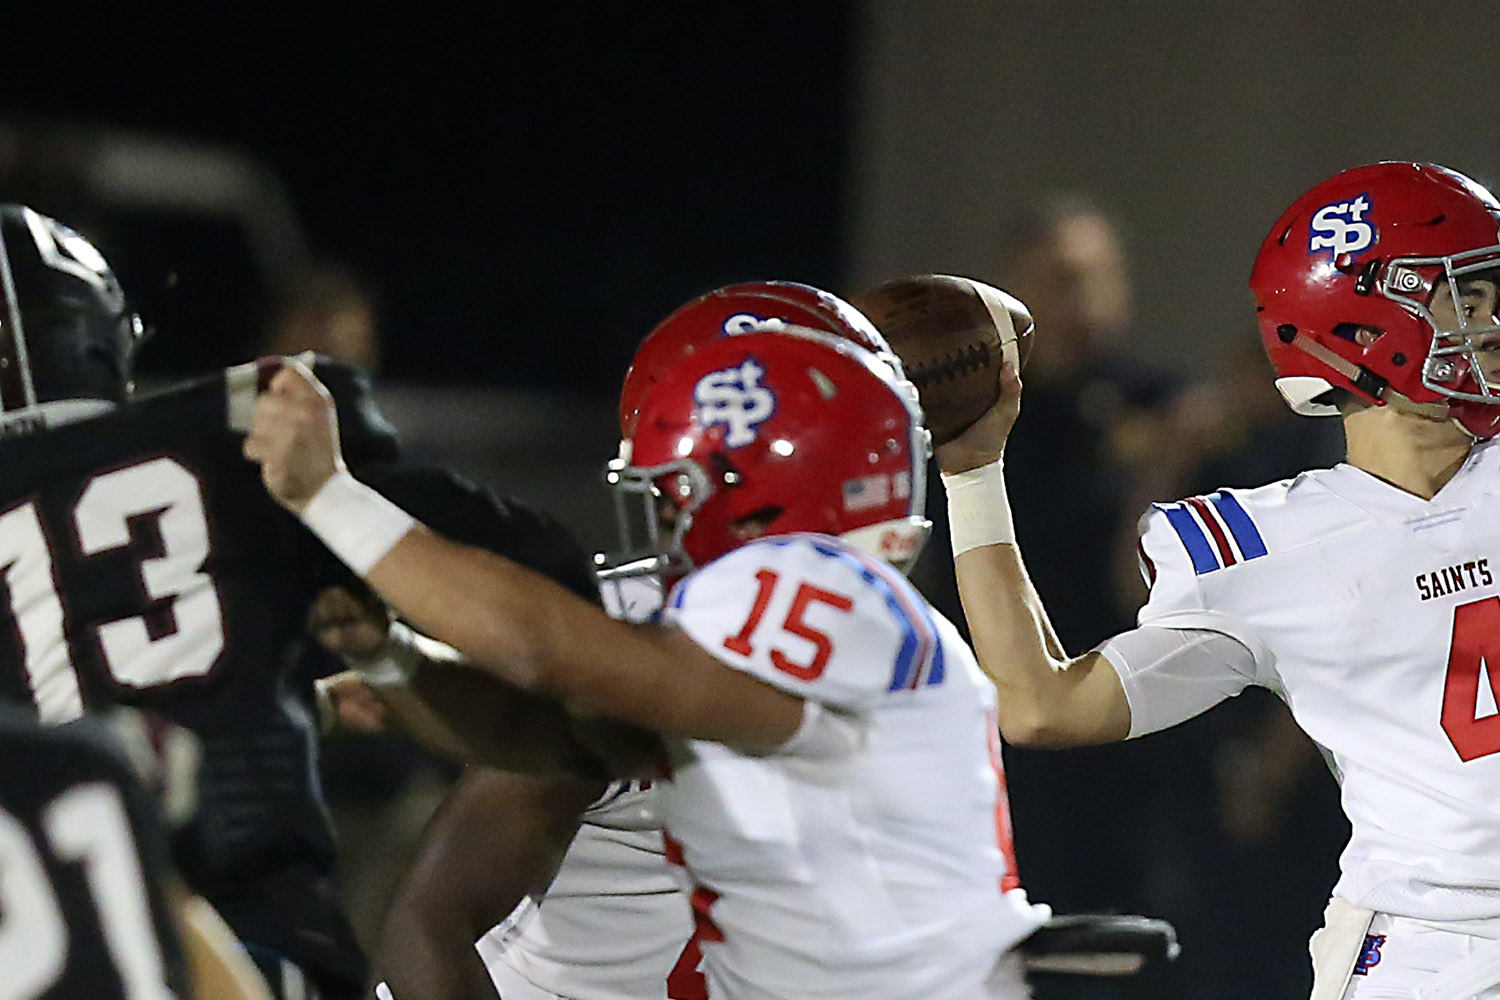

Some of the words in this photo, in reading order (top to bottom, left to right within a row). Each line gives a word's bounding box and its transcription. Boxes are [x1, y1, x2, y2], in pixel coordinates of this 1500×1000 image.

[0, 457, 226, 726] 13
[722, 567, 856, 683] 15
[1415, 558, 1494, 602] SAINTS
